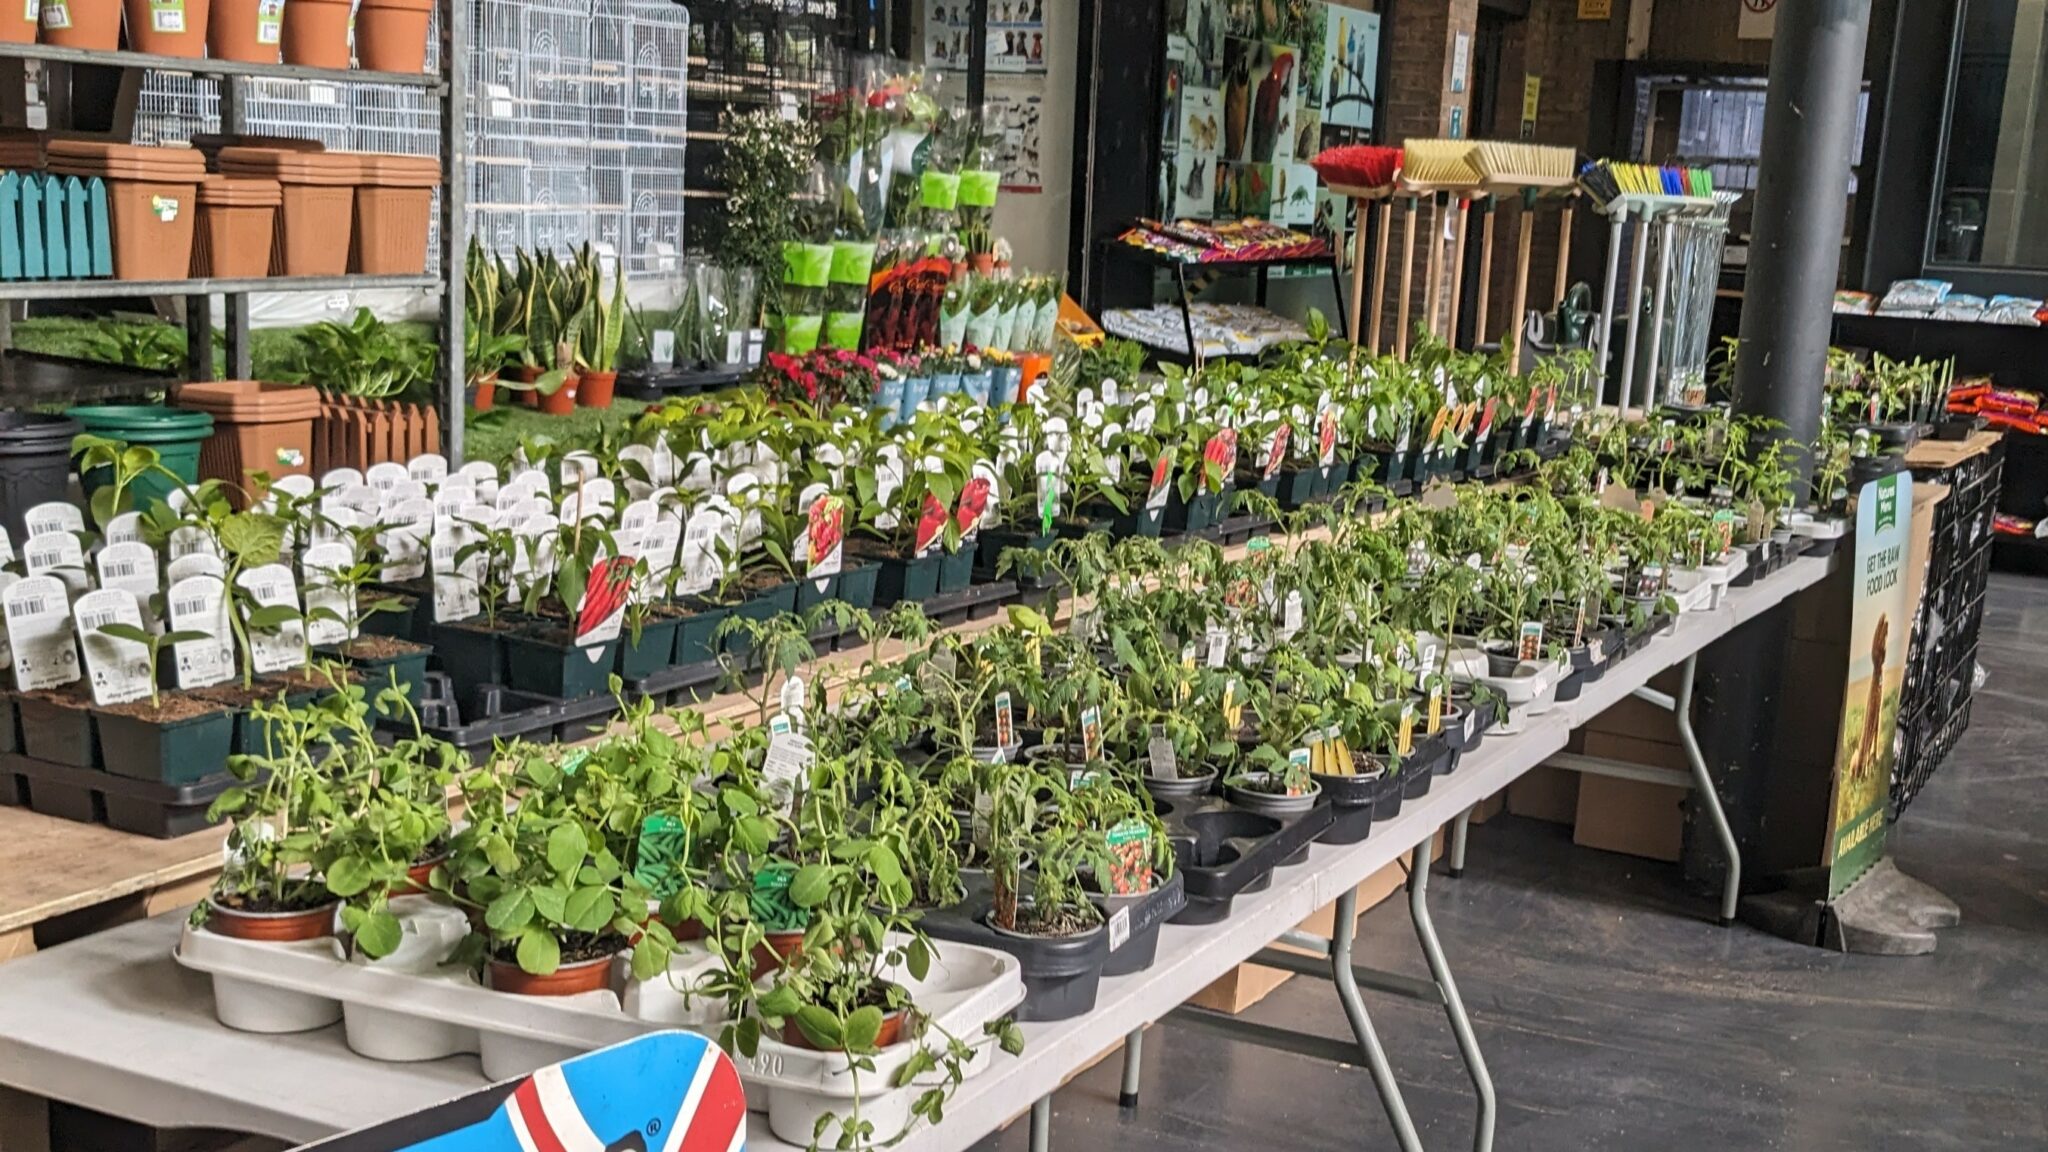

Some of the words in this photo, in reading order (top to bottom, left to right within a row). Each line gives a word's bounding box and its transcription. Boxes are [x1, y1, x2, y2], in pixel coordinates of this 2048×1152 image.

[1866, 554, 1876, 575] GET
[1877, 549, 1887, 569] THE
[1888, 544, 1901, 565] RAW
[1866, 576, 1882, 598] FOOD
[1883, 568, 1898, 590] LOOK
[1837, 818, 1869, 859] AVAILABLE
